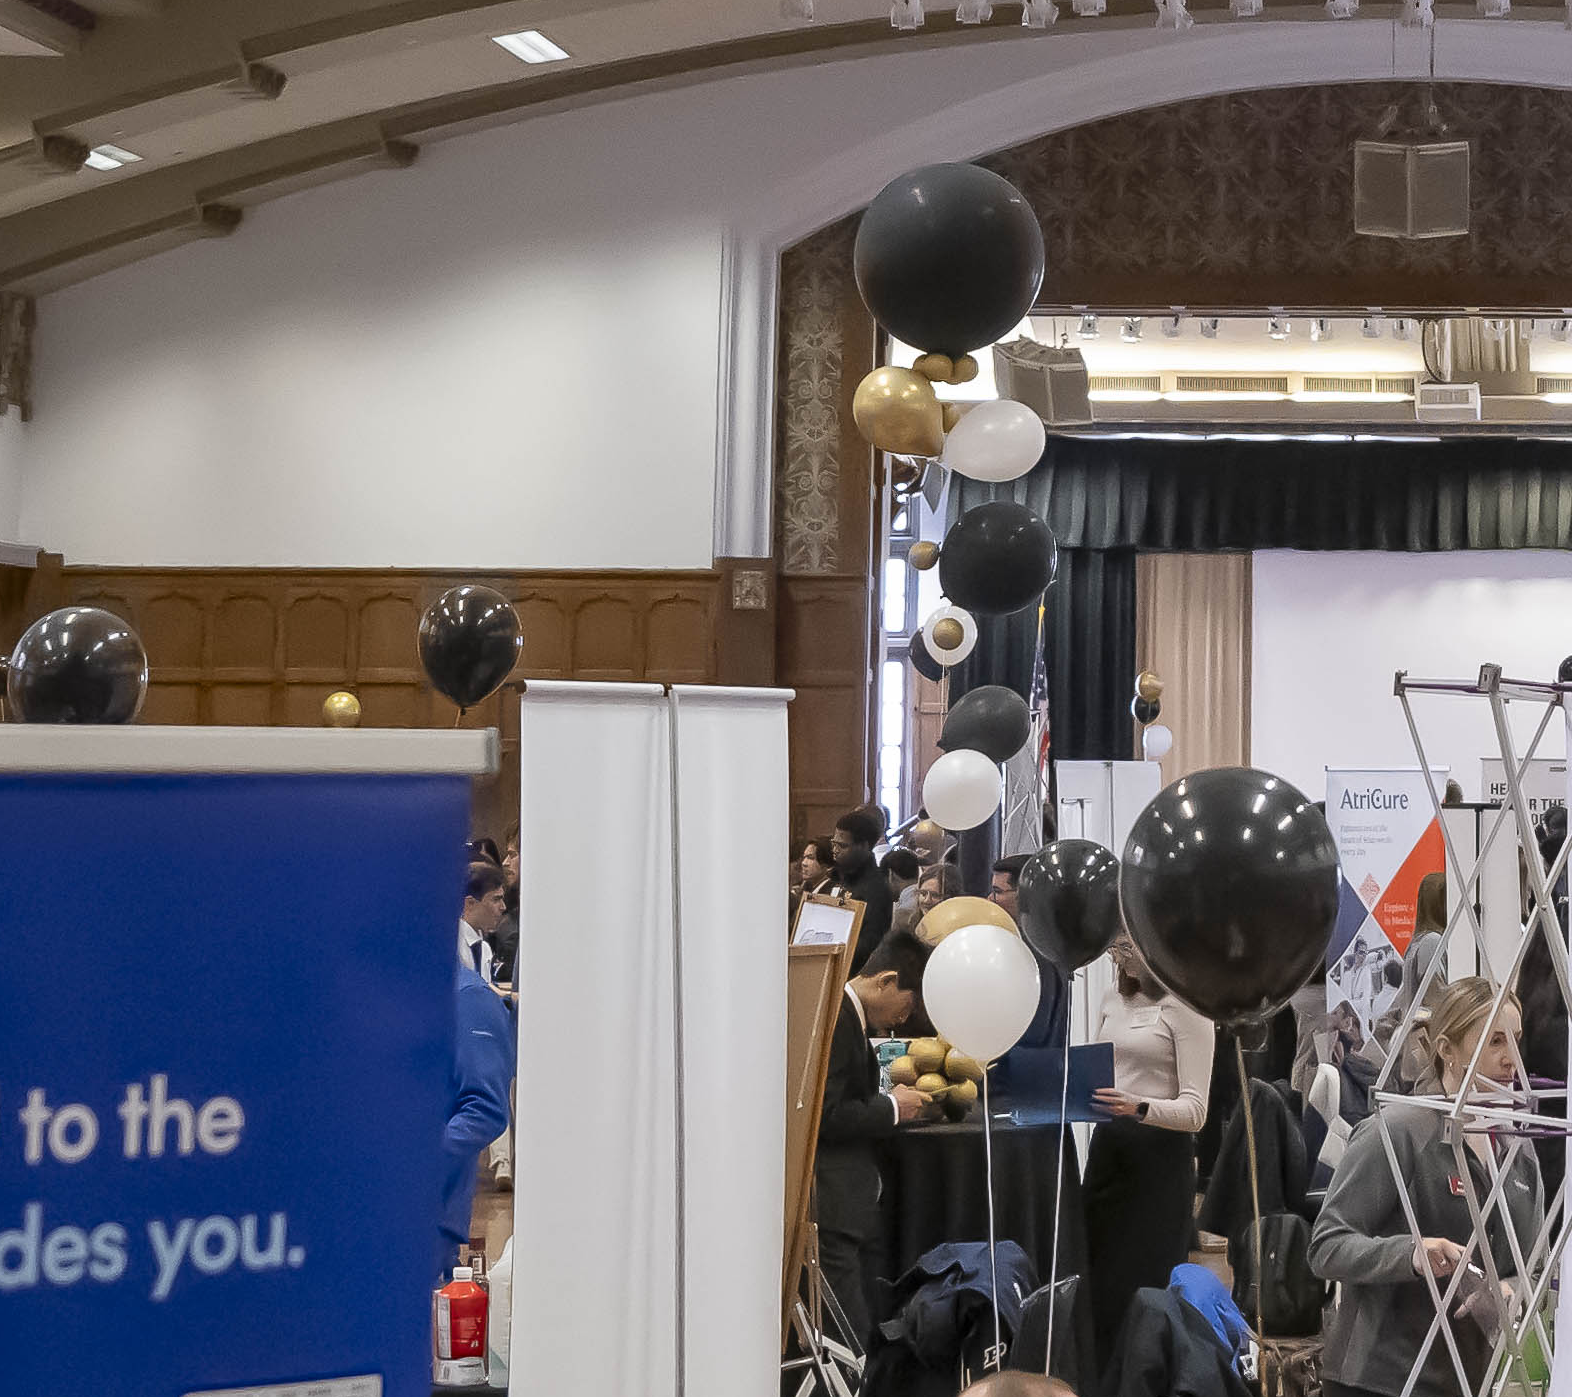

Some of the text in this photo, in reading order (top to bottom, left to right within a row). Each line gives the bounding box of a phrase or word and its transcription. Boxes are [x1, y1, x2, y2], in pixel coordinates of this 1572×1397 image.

[1340, 787, 1409, 810] AtriCure
[19, 1088, 100, 1165] to
[118, 1073, 245, 1159] the
[147, 1211, 306, 1300] you.
